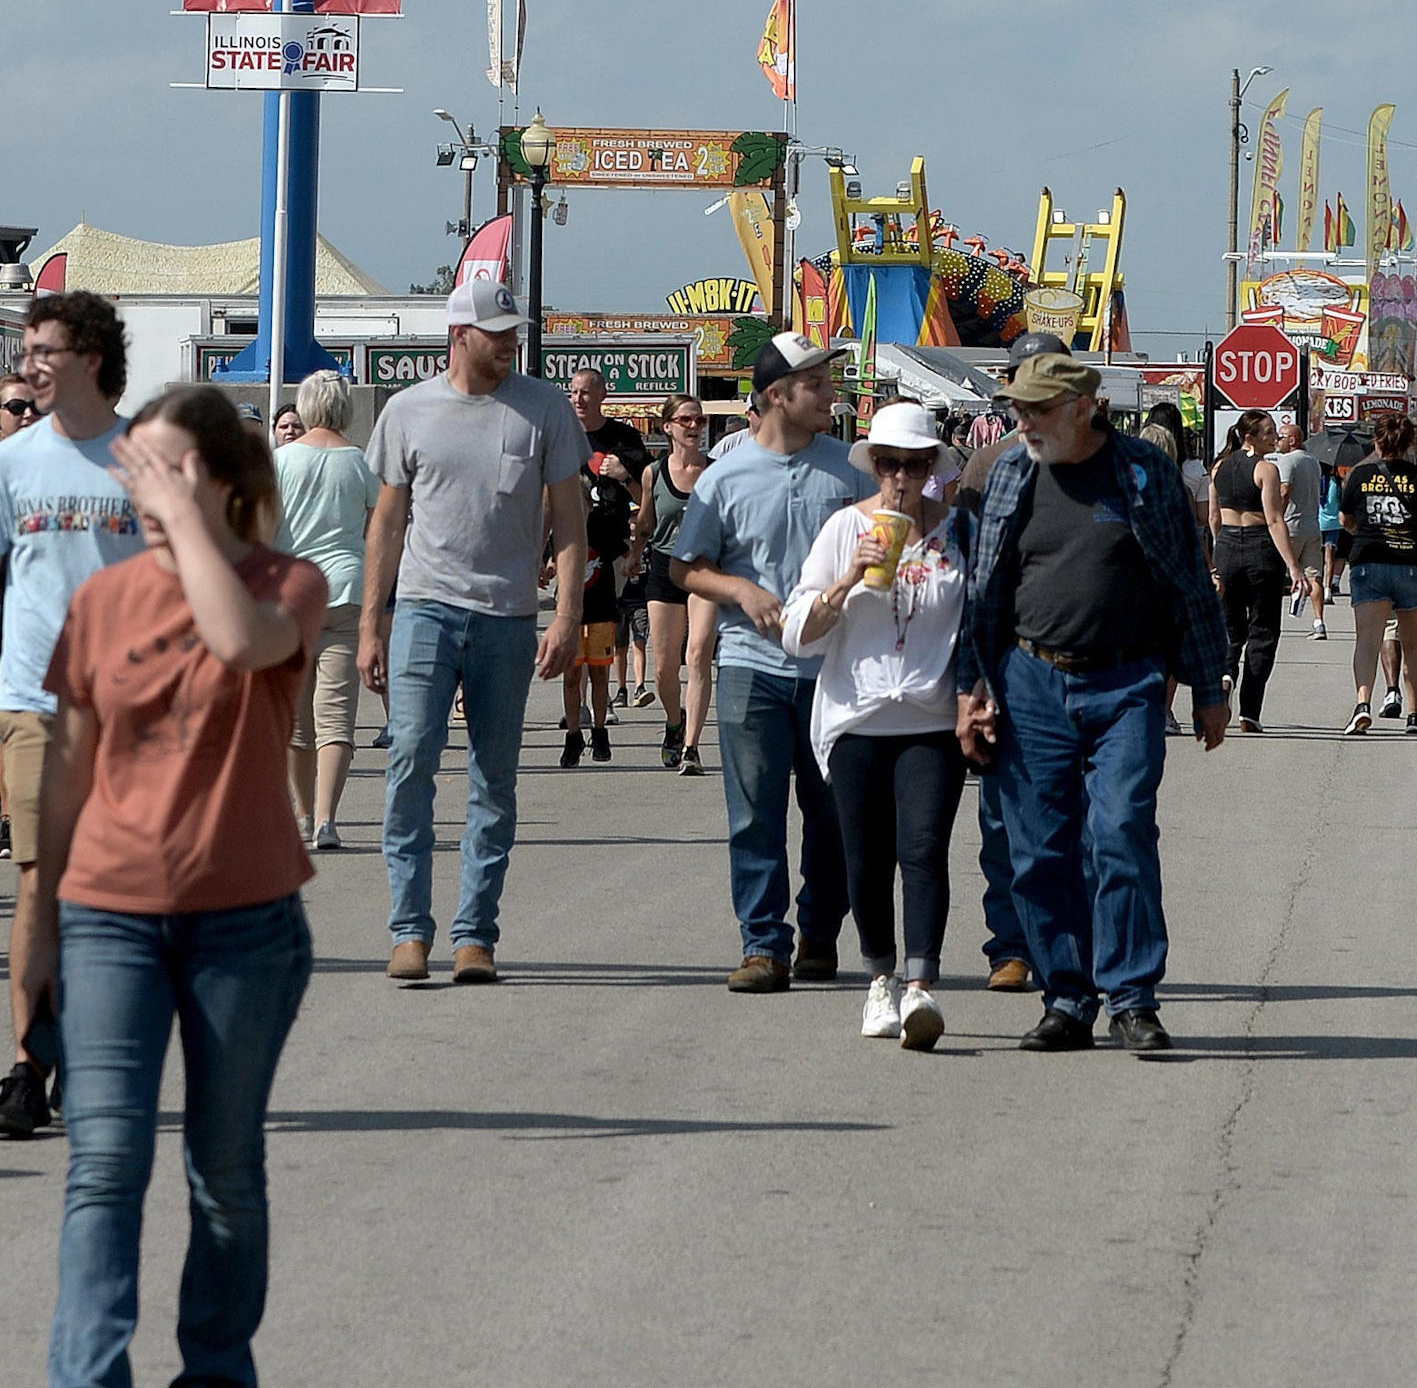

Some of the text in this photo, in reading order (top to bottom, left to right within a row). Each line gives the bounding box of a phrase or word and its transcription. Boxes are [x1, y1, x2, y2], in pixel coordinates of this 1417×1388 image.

[214, 35, 281, 49] ILLINOIS
[211, 50, 355, 72] STATE FAIR
[592, 139, 693, 150] FRESH BREWED
[594, 150, 643, 170] ICED
[695, 146, 709, 175] 2
[589, 320, 689, 330] FRESH BREWED
[1031, 313, 1074, 328] SHAKE-UPS
[377, 356, 448, 380] SAUS
[545, 354, 680, 379] STEAK ON A STICK
[1219, 350, 1294, 383] STOP
[635, 382, 677, 391] REFILLS
[1379, 375, 1407, 390] FRIES
[1325, 397, 1353, 418] KES
[1361, 399, 1405, 412] LEMONADE
[1370, 474, 1408, 484] JOAS
[16, 496, 55, 516] ONAS
